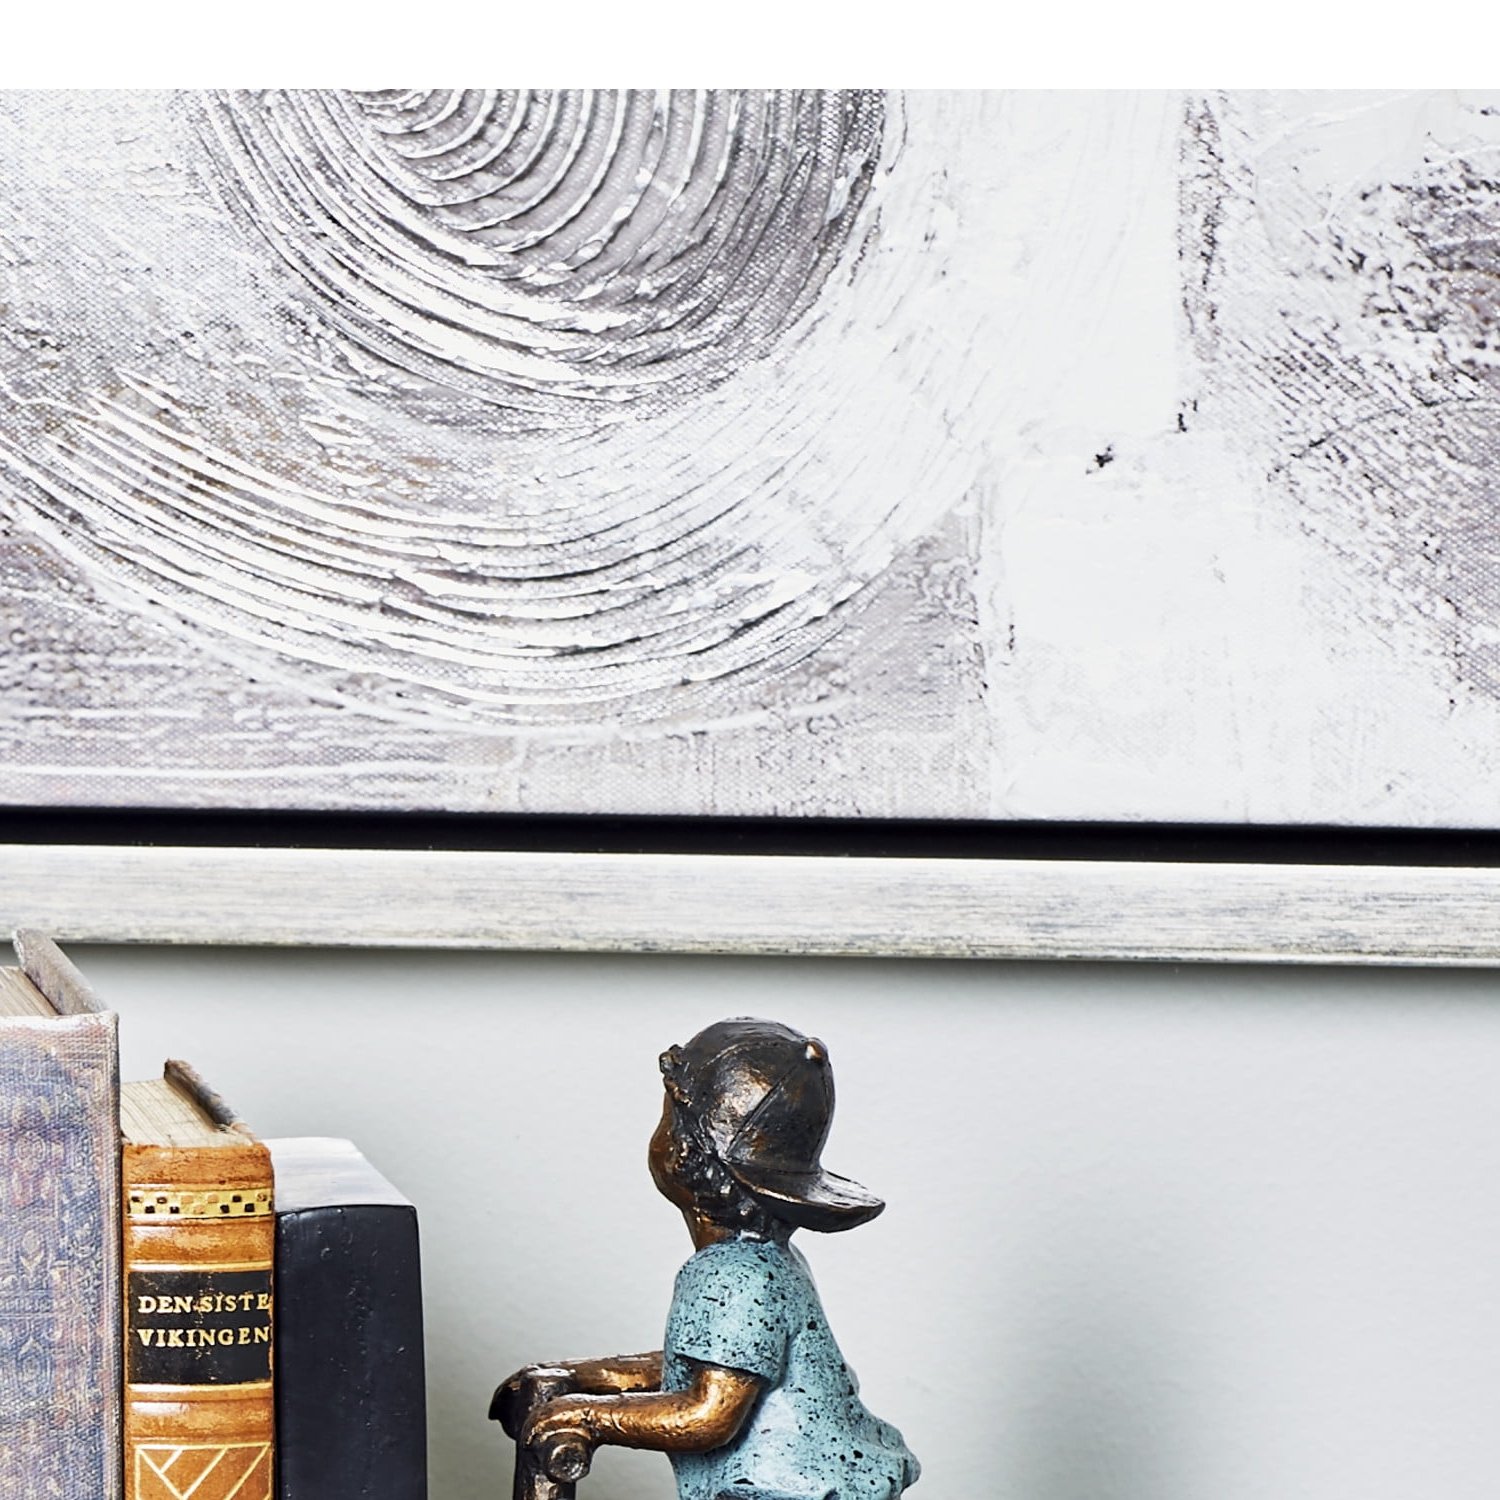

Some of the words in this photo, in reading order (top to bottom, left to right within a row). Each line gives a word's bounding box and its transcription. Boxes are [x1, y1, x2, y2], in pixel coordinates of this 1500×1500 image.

[137, 1295, 194, 1314] DEN
[199, 1292, 271, 1313] SISTE
[136, 1326, 270, 1347] VIKINGEN
